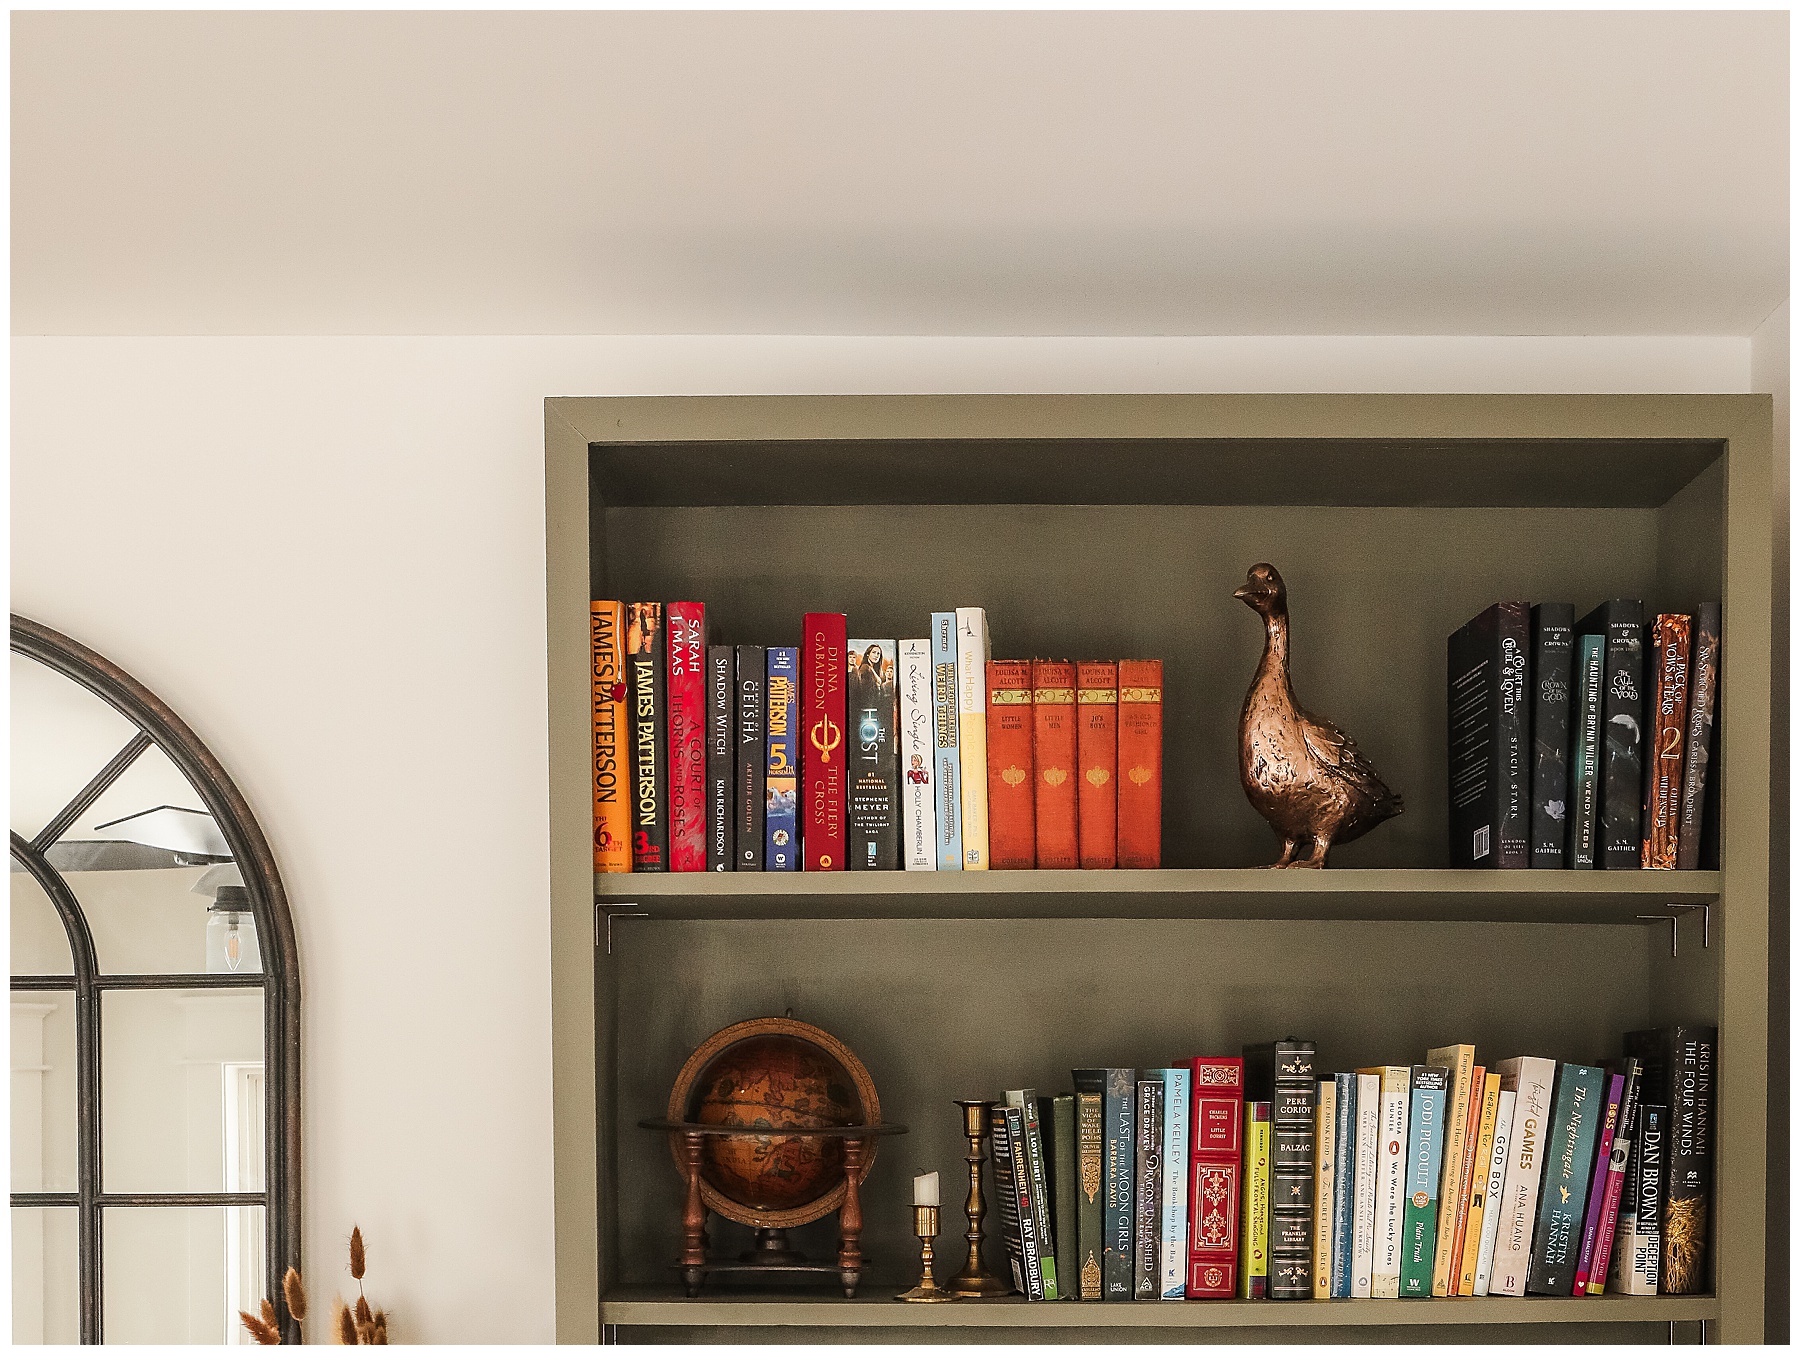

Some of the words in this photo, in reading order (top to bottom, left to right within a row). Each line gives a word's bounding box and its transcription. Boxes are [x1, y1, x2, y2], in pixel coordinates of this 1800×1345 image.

[670, 616, 682, 628] J.
[591, 611, 614, 677] JAMES
[672, 630, 683, 676] MAAS
[689, 619, 700, 672] SARAH
[634, 661, 654, 717] JAMES
[716, 658, 727, 709] SHADOW
[815, 632, 825, 710] GABALDON
[828, 647, 837, 692] DIANA
[906, 664, 924, 704] Living
[936, 663, 946, 702] WEIRD
[1588, 660, 1600, 702] HAUNTING
[742, 680, 755, 743] GEISHA
[769, 676, 787, 736] PATTERSON
[937, 705, 947, 748] THINGS
[593, 677, 617, 803] PATTERSON
[716, 715, 727, 755] WITCH
[860, 708, 878, 764] HOST
[907, 709, 926, 751] Single
[1586, 715, 1597, 742] BRYNN
[1660, 727, 1680, 760] 2
[638, 722, 656, 825] PATTERSON
[828, 766, 837, 794] THE
[1585, 745, 1595, 776] WILDER
[717, 780, 725, 796] KIM
[815, 781, 825, 825] CROSS
[716, 799, 725, 855] RICHARDSON
[828, 800, 838, 839] FIERY
[1685, 1041, 1697, 1065] THE
[1574, 1086, 1586, 1107] The
[1683, 1070, 1695, 1107] FOUR
[1119, 1112, 1130, 1141] LAST
[1421, 1094, 1433, 1126] JODI
[1120, 1142, 1126, 1151] OF
[1494, 1136, 1505, 1165] GOD
[1520, 1119, 1537, 1170] GAMES
[1561, 1111, 1581, 1179] Nightingale
[1643, 1131, 1661, 1165] DAN
[1680, 1113, 1693, 1156] WINDS
[1014, 1141, 1028, 1195] FAHRENHEIT
[1392, 1162, 1398, 1175] We
[1416, 1129, 1432, 1187] PICOULT
[1119, 1168, 1130, 1212] MOON
[1489, 1172, 1501, 1199] BOX
[1641, 1168, 1658, 1220] BROWN
[1022, 1219, 1034, 1239] RAY
[1118, 1216, 1129, 1250] GIRLS
[1386, 1218, 1395, 1242] Lucky
[1414, 1221, 1424, 1241] Plain
[1545, 1210, 1561, 1264] HANNAH
[1556, 1213, 1571, 1264] KRISTIN
[1024, 1242, 1040, 1295] BRADBURY
[1413, 1242, 1422, 1263] Truth
[1635, 1247, 1647, 1274] POINT
[1646, 1236, 1659, 1285] DECEPTION
